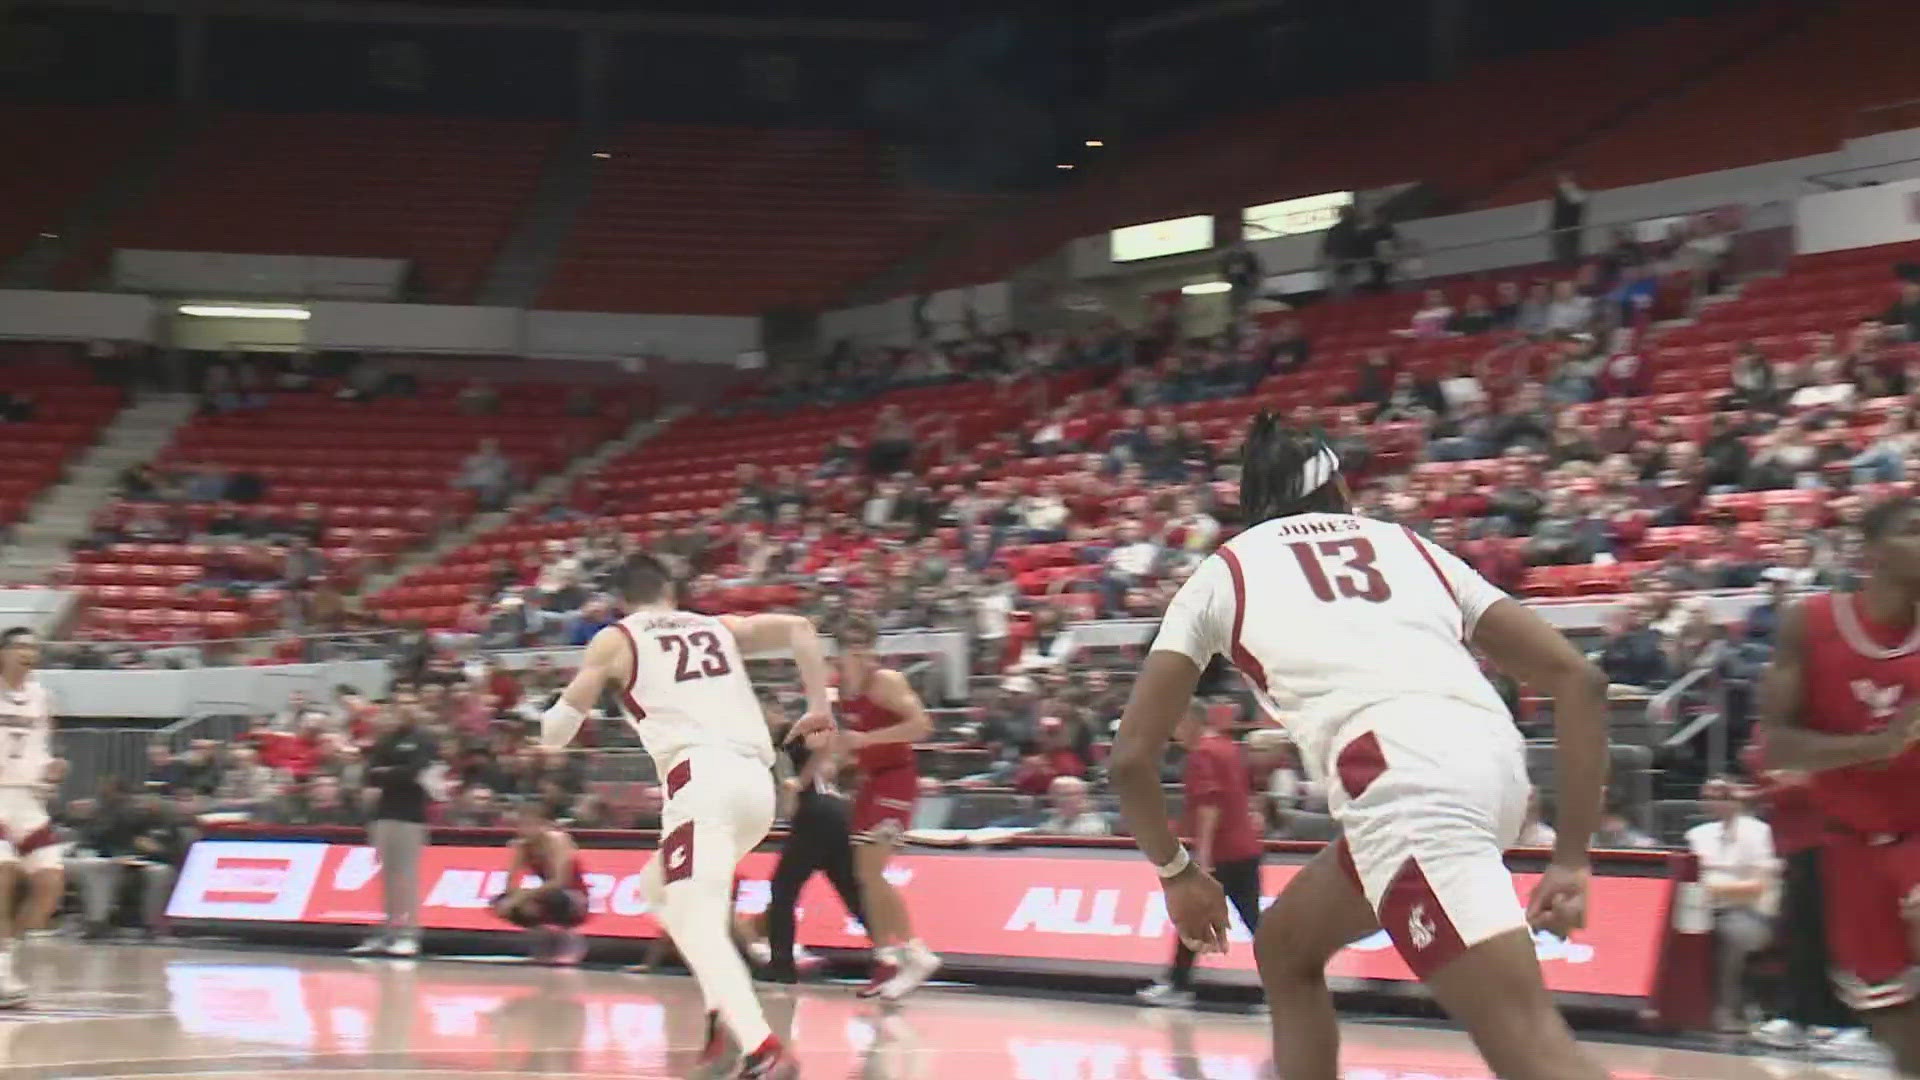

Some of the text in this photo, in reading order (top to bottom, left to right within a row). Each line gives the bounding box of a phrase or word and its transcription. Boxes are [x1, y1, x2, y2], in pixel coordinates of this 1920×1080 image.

[1278, 519, 1360, 537] JONES
[1282, 537, 1392, 604] 13
[654, 631, 732, 683] 23
[1003, 886, 1133, 936] ALL
